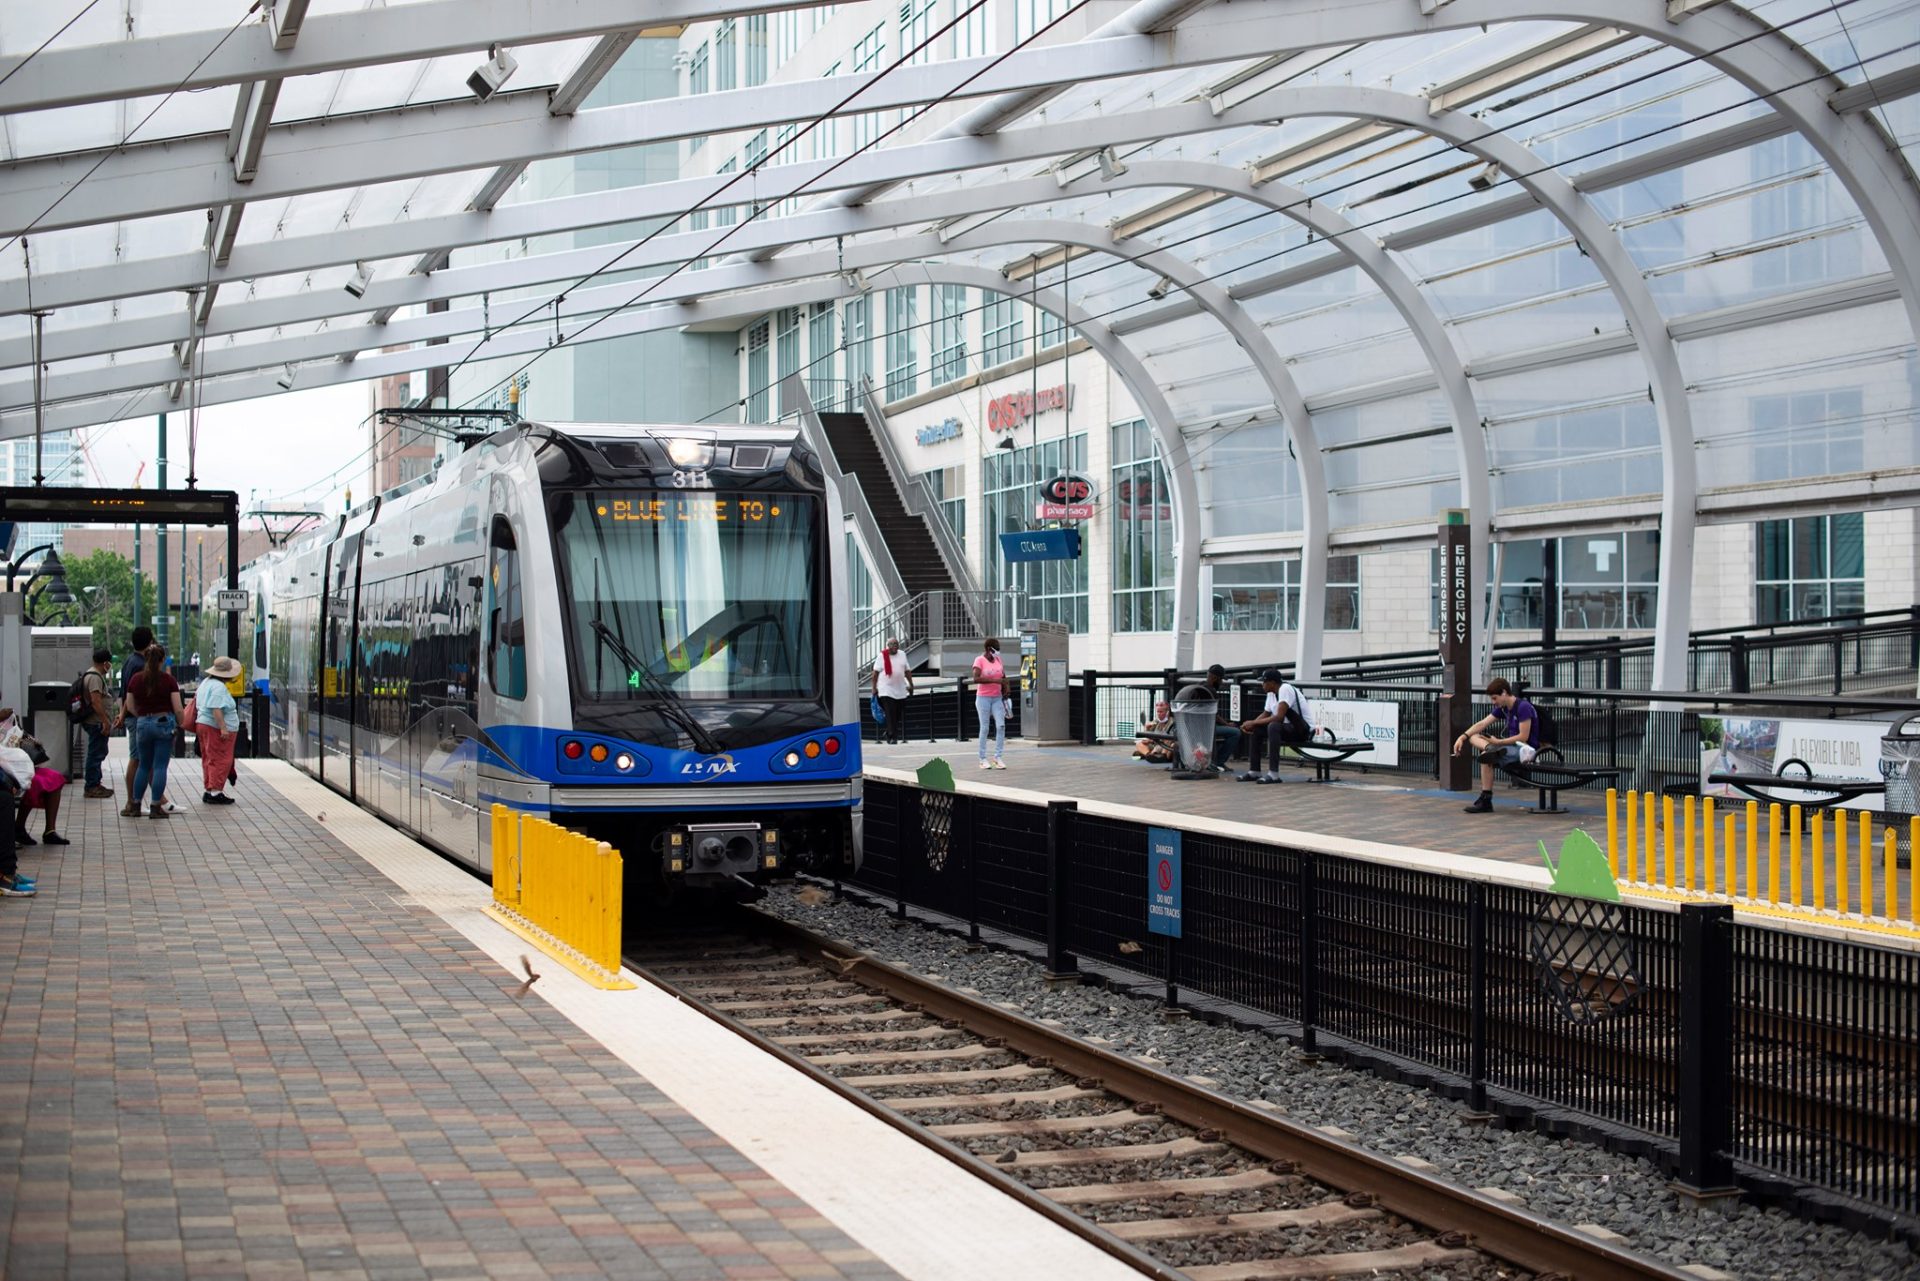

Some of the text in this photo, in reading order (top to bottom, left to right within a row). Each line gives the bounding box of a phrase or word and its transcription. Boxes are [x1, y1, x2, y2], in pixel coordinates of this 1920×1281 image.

[672, 471, 709, 489] 311
[1055, 481, 1089, 498] CVS
[613, 501, 666, 521] BLUE
[739, 501, 765, 521] TO
[1440, 545, 1448, 644] EMERGENCY
[1455, 544, 1466, 644] EMERGENCY
[1363, 722, 1395, 740] QUEENS
[1800, 738, 1838, 765] FLEXIBLE
[1840, 741, 1862, 767] MBA
[1155, 844, 1174, 856] DANGER
[1156, 894, 1173, 905] DO NOT
[1149, 904, 1180, 918] CROSS TRACKS
